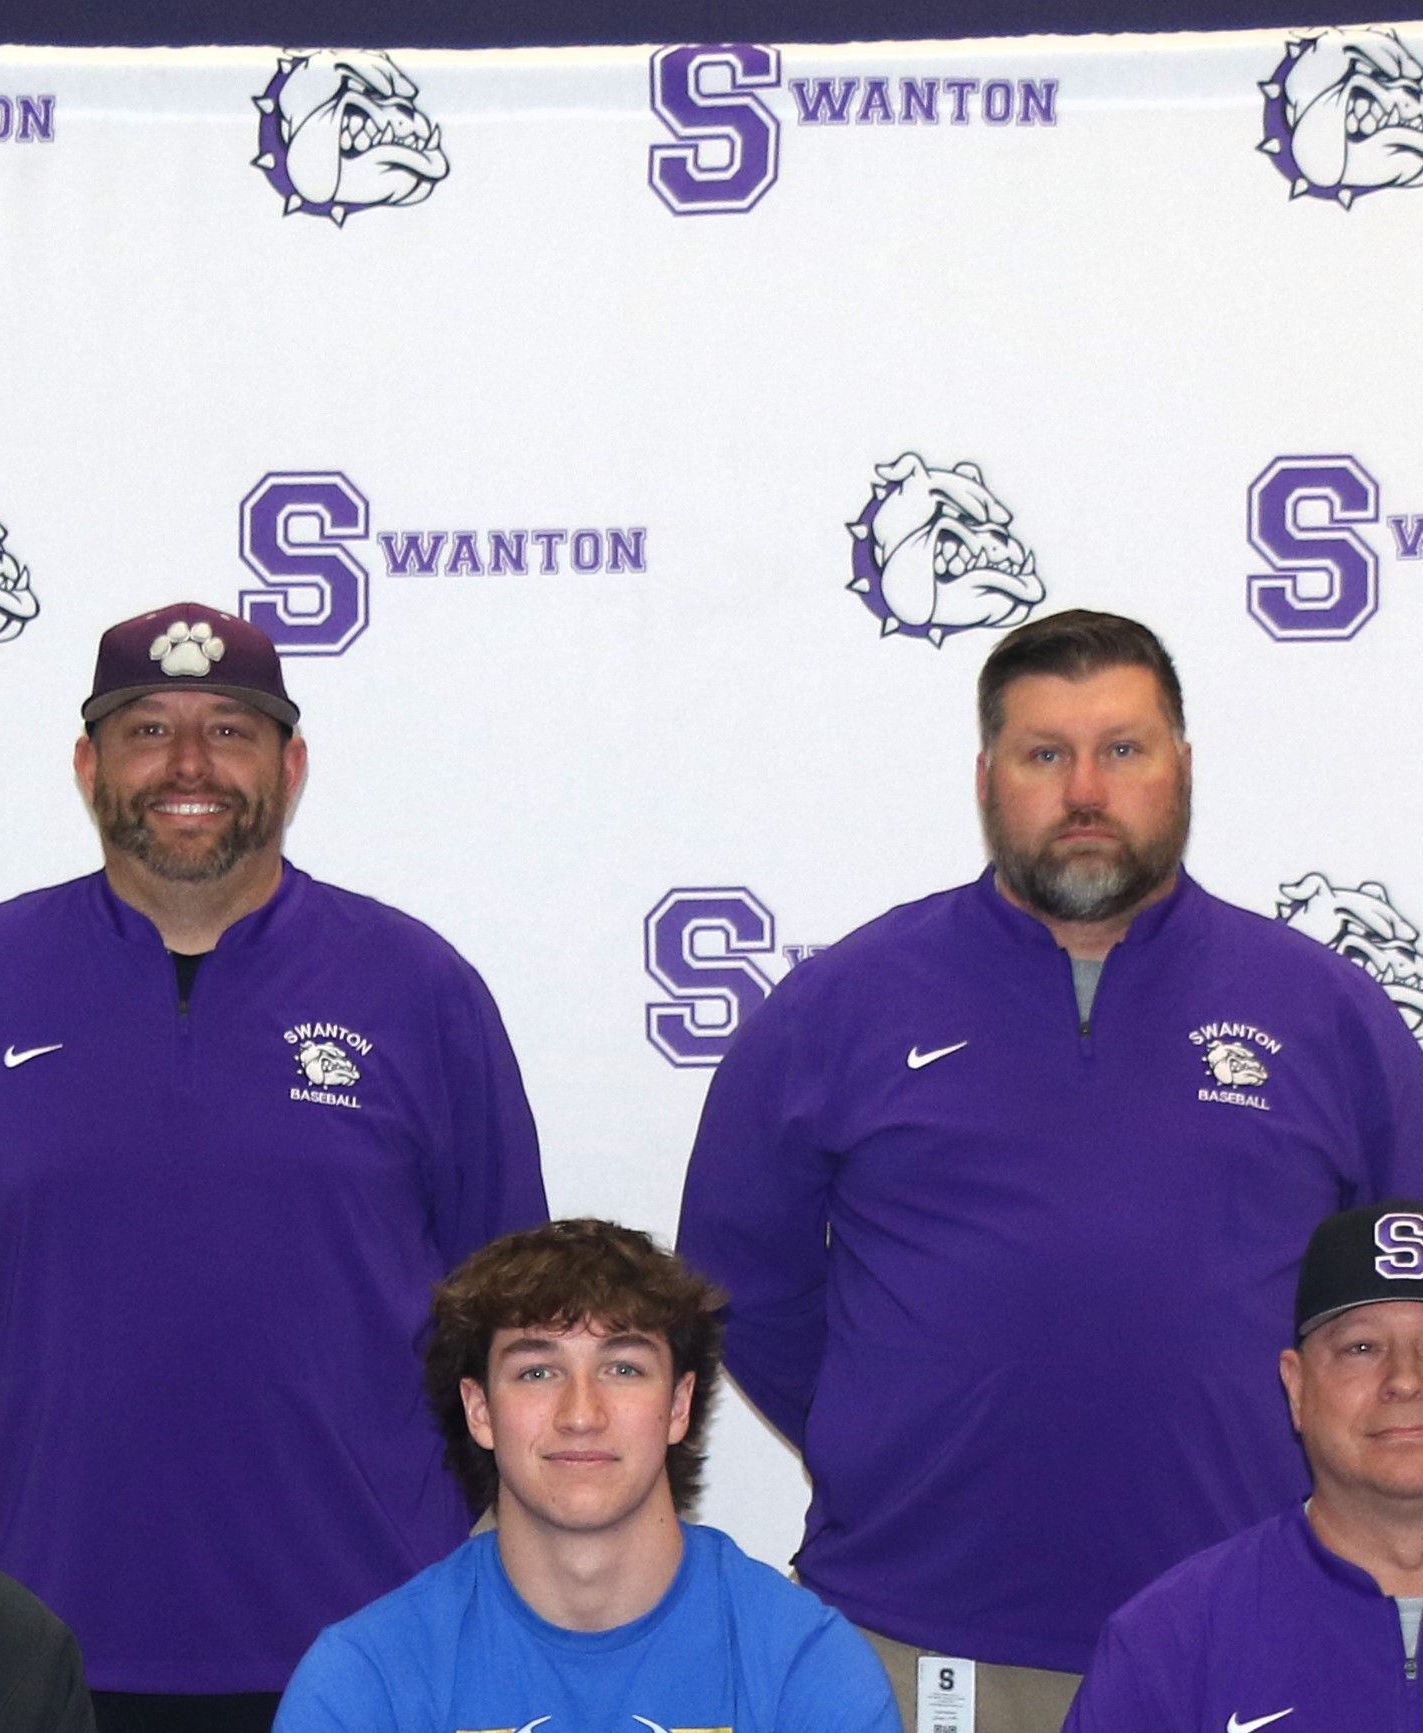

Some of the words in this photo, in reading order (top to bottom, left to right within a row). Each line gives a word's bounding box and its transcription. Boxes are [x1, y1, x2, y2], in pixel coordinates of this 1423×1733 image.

[648, 43, 1059, 217] SWANTON
[239, 471, 647, 657] SWANTON
[283, 1022, 373, 1056] SWANTON
[1188, 1022, 1282, 1055] SWANTON
[290, 1087, 361, 1109] BASEBALL
[1198, 1088, 1270, 1111] BASEBALL
[939, 1667, 955, 1690] S
